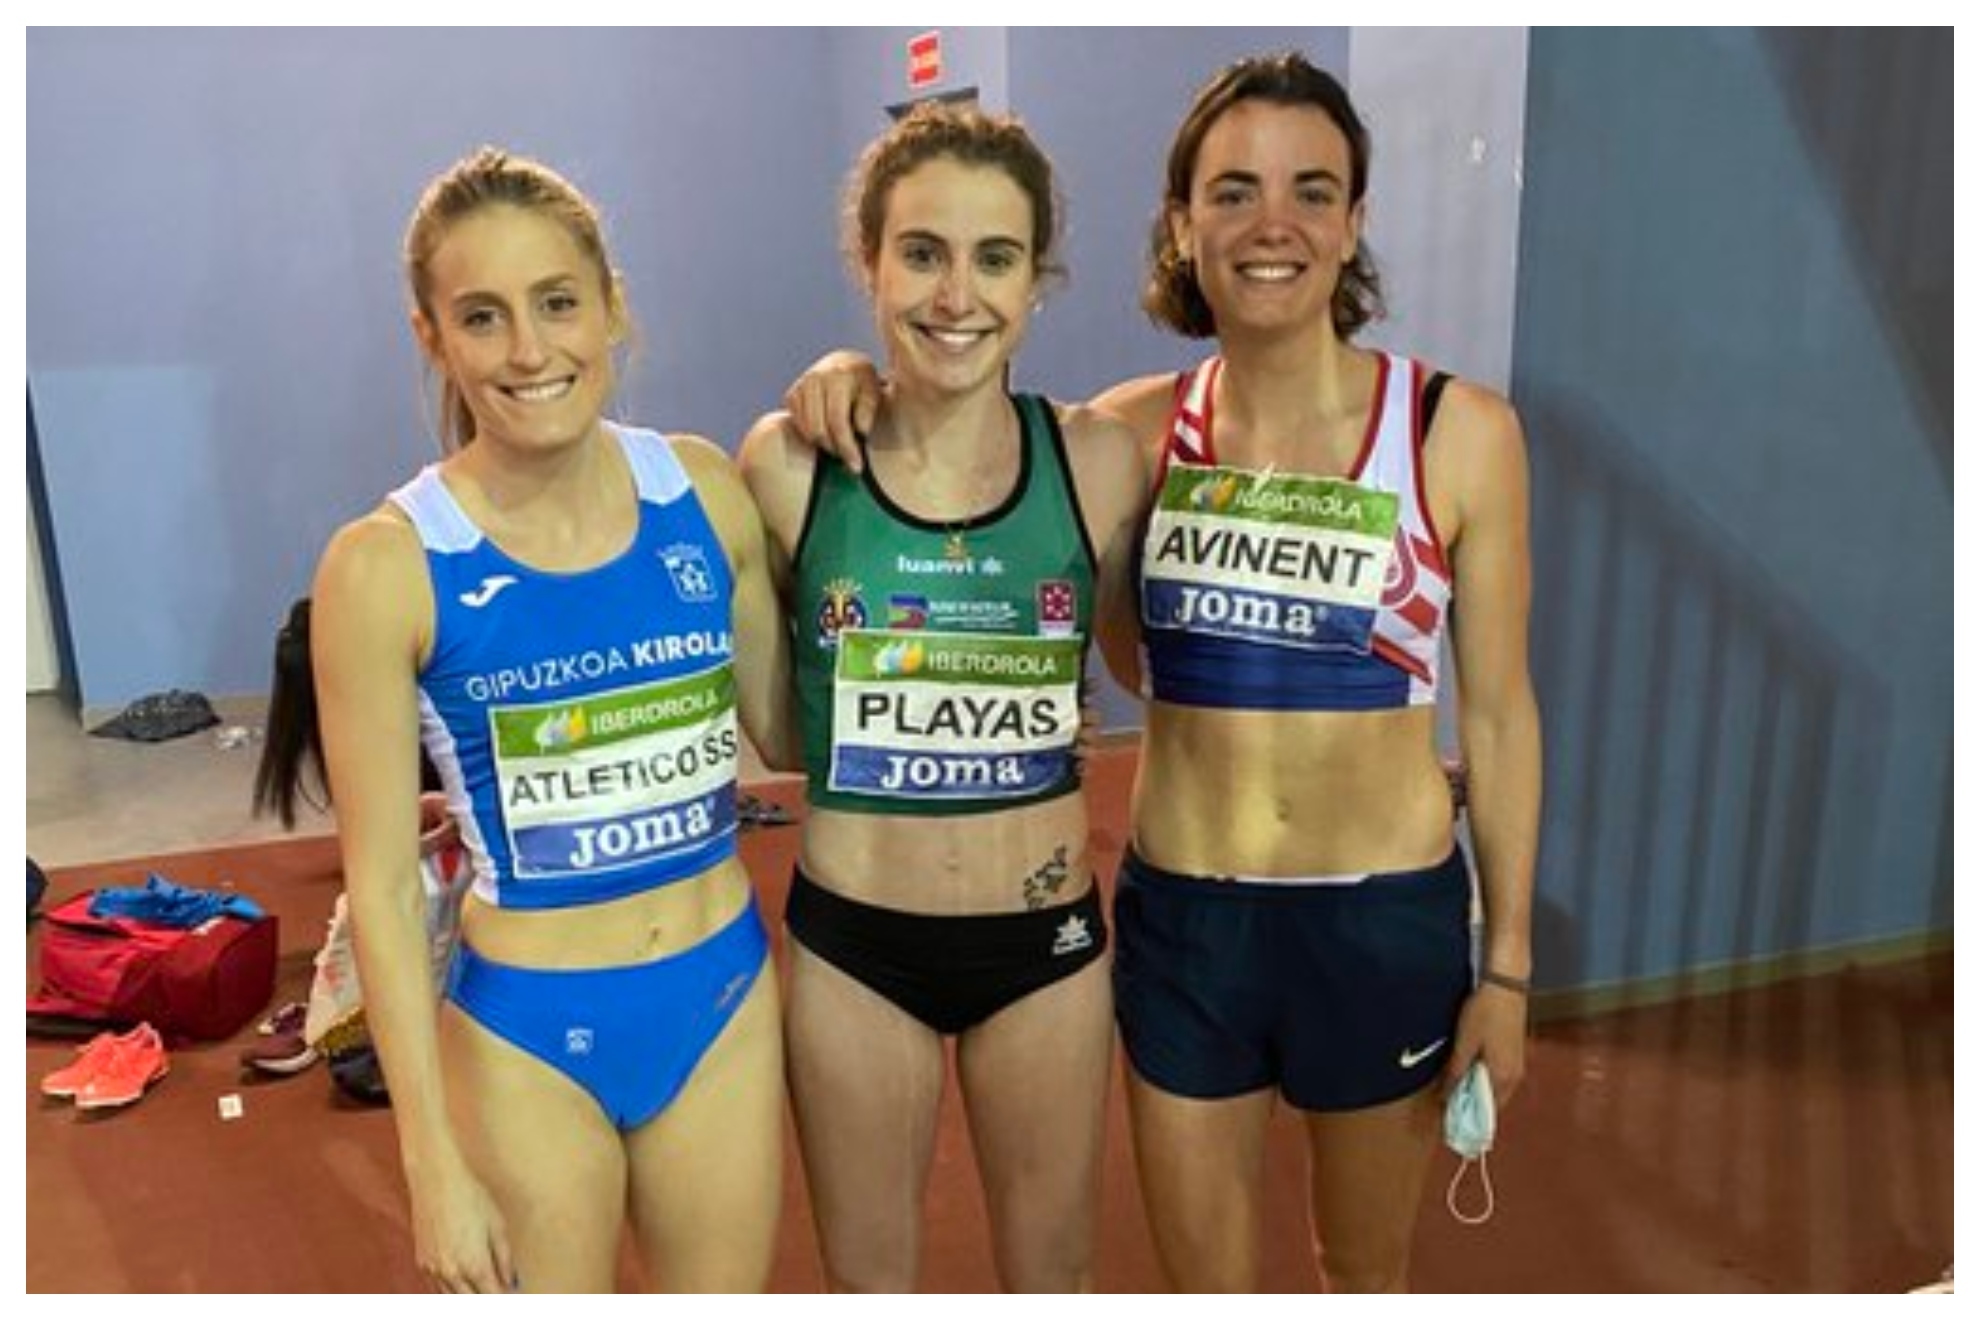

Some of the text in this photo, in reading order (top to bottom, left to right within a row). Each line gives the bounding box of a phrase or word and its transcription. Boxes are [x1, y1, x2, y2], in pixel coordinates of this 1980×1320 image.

[1156, 524, 1374, 588] AVINENT
[465, 649, 628, 701] GIPUZKOA
[928, 652, 1057, 676] IBERDROLA
[591, 688, 719, 736] IBERDROLA
[856, 692, 1060, 739] PLAYAS
[508, 730, 737, 806] ATLETICO SS
